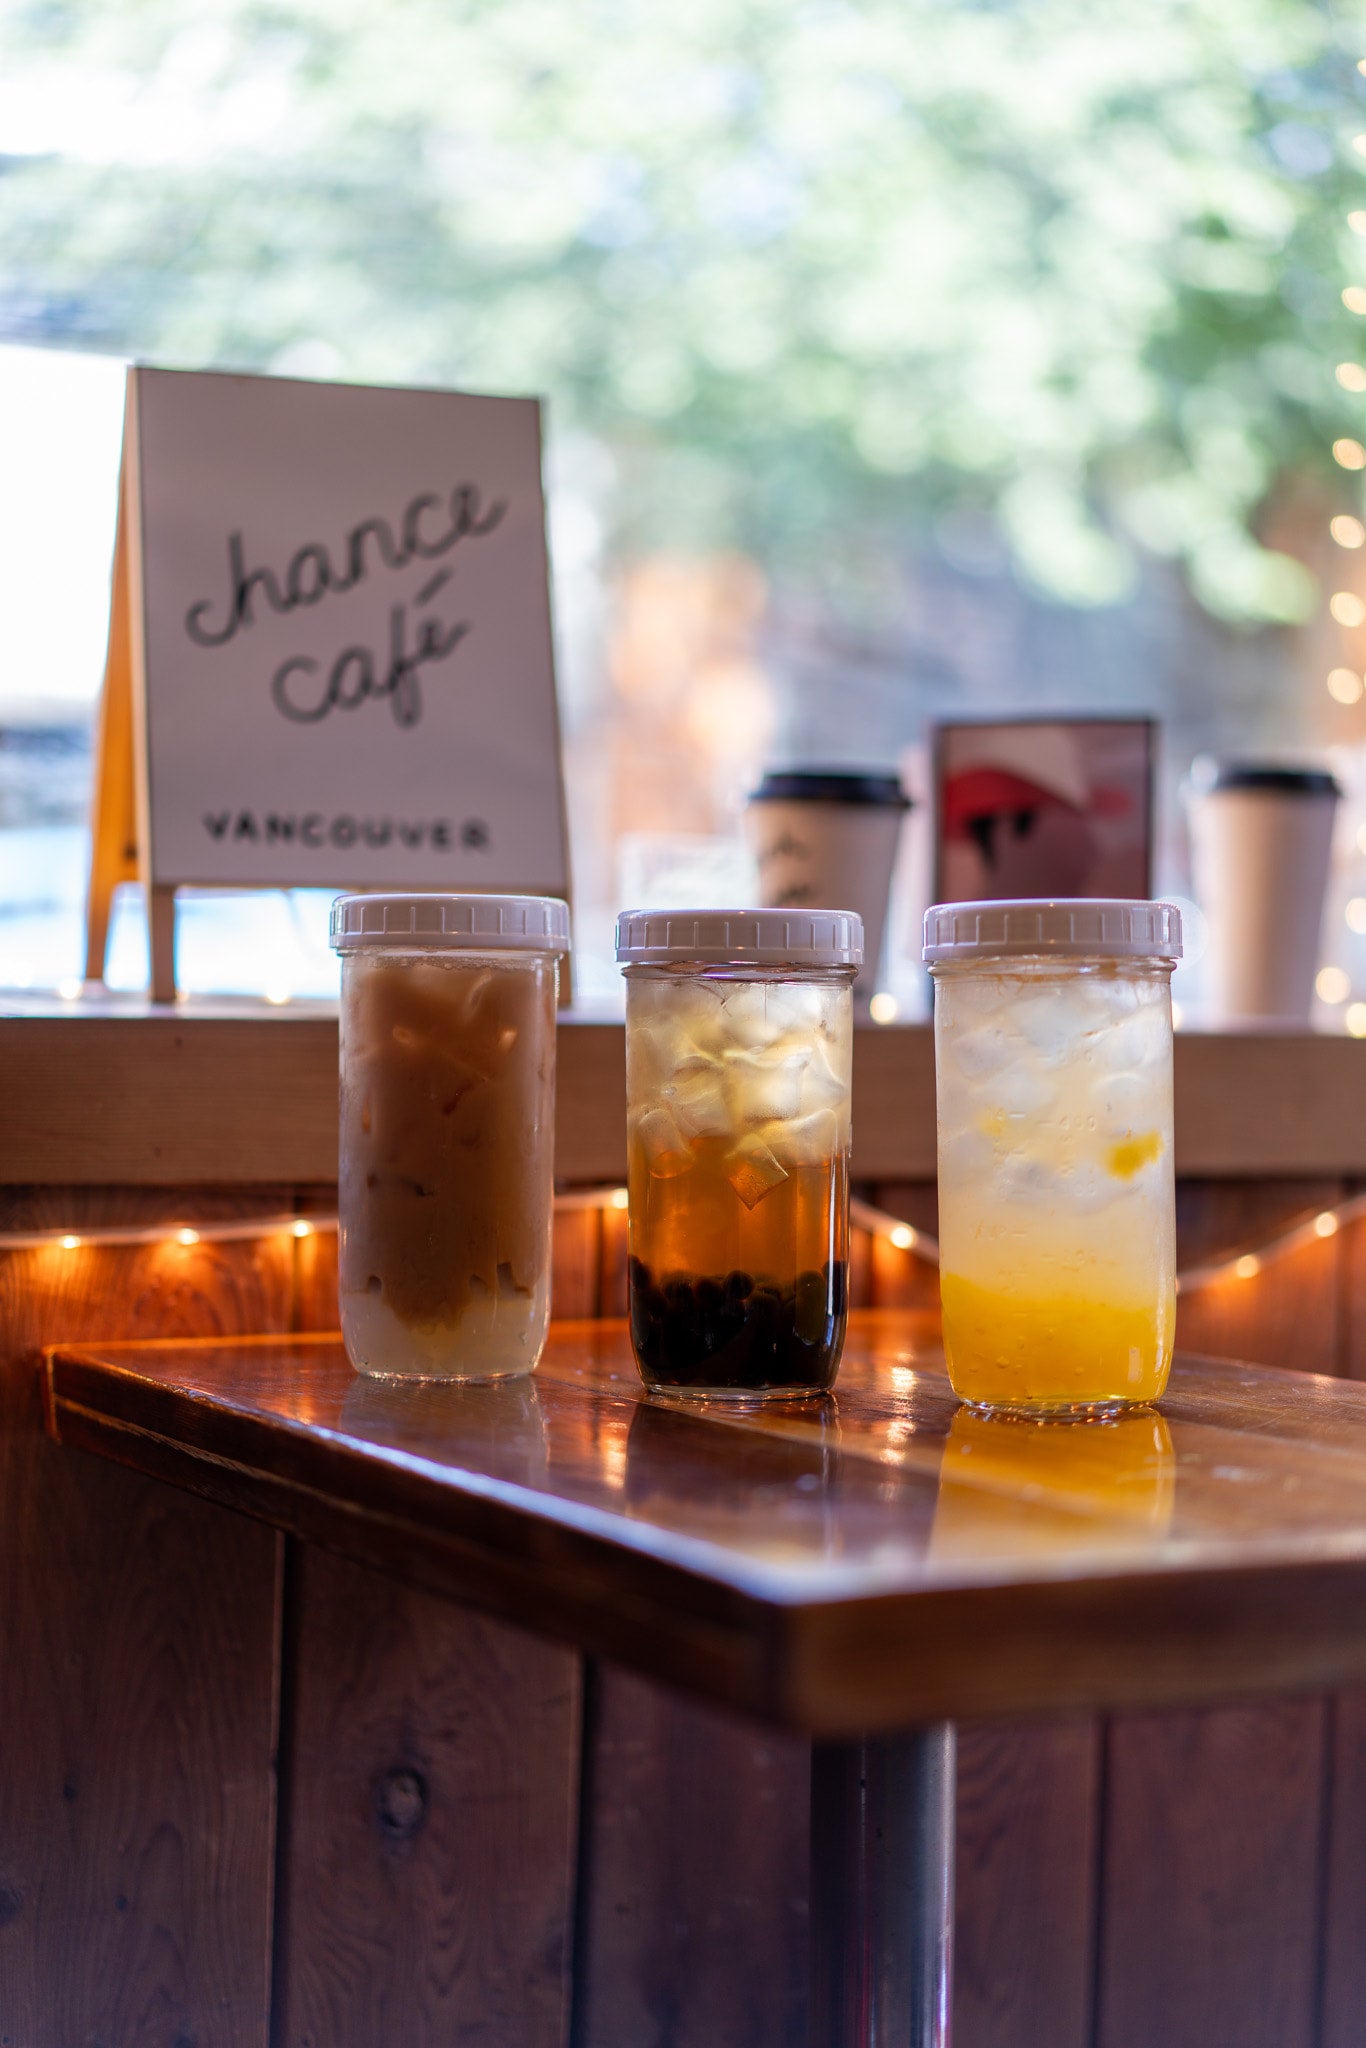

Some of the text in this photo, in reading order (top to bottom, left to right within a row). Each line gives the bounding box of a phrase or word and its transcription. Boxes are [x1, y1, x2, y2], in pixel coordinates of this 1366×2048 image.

[184, 481, 508, 648] chance
[271, 565, 471, 730] café
[203, 809, 493, 854] VANCOUVER
